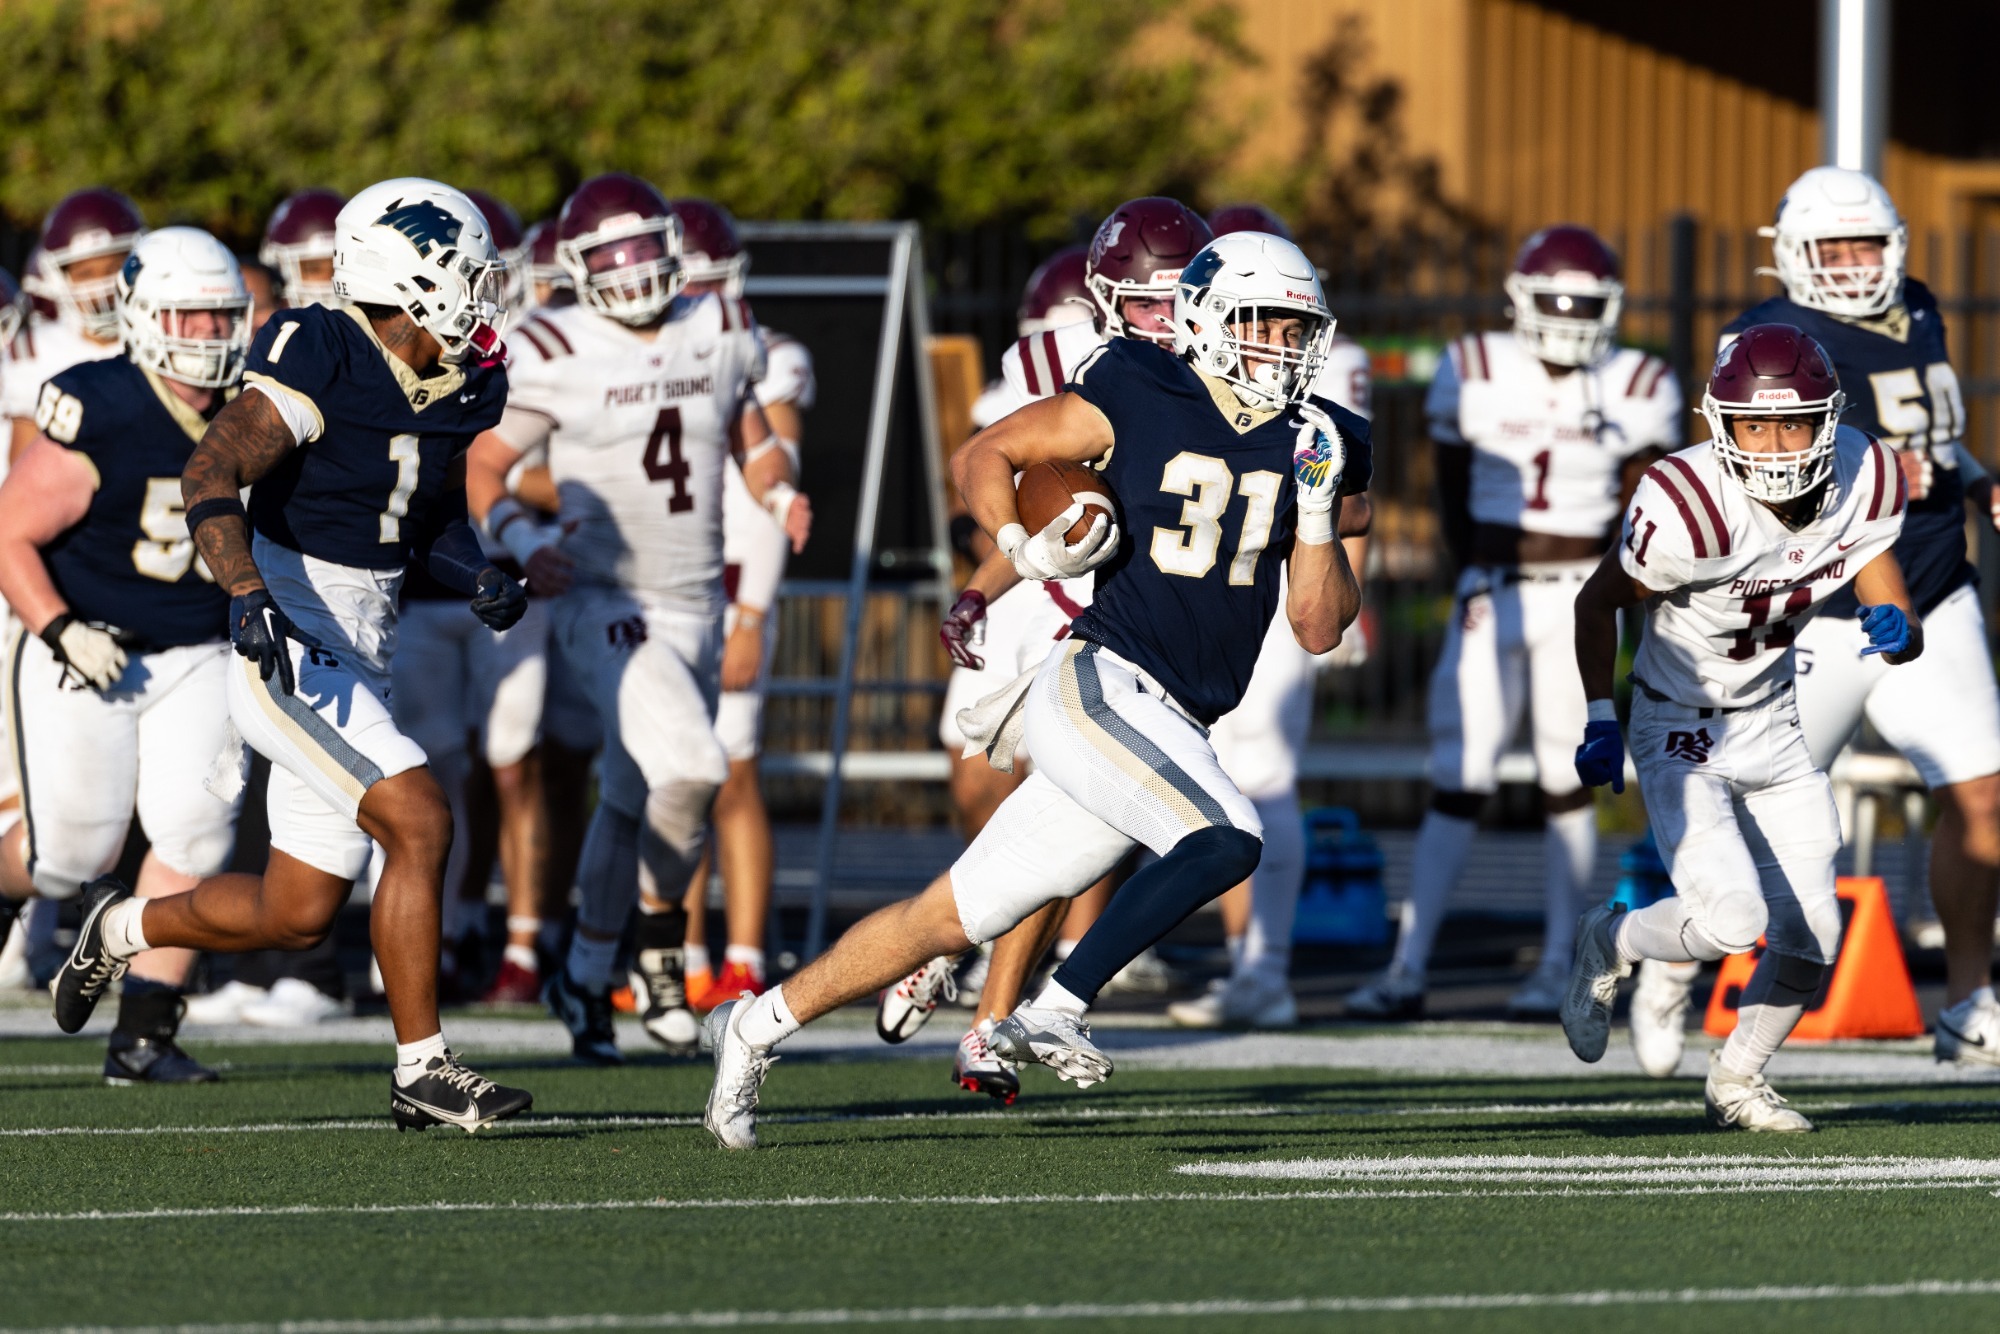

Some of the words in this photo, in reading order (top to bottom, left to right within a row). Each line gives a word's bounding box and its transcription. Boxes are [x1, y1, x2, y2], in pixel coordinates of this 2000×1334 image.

[1157, 273, 1180, 281] Ridd
[1286, 290, 1317, 303] Riddell
[267, 321, 301, 364] 1
[1758, 391, 1794, 400] Riddell
[1868, 361, 1966, 470] 50
[378, 433, 420, 544] 1
[642, 406, 695, 514] 4
[1525, 449, 1552, 512] 1
[132, 477, 215, 583] 5
[1150, 451, 1284, 586] 31
[1625, 506, 1658, 568] 11
[1727, 587, 1812, 661] 11
